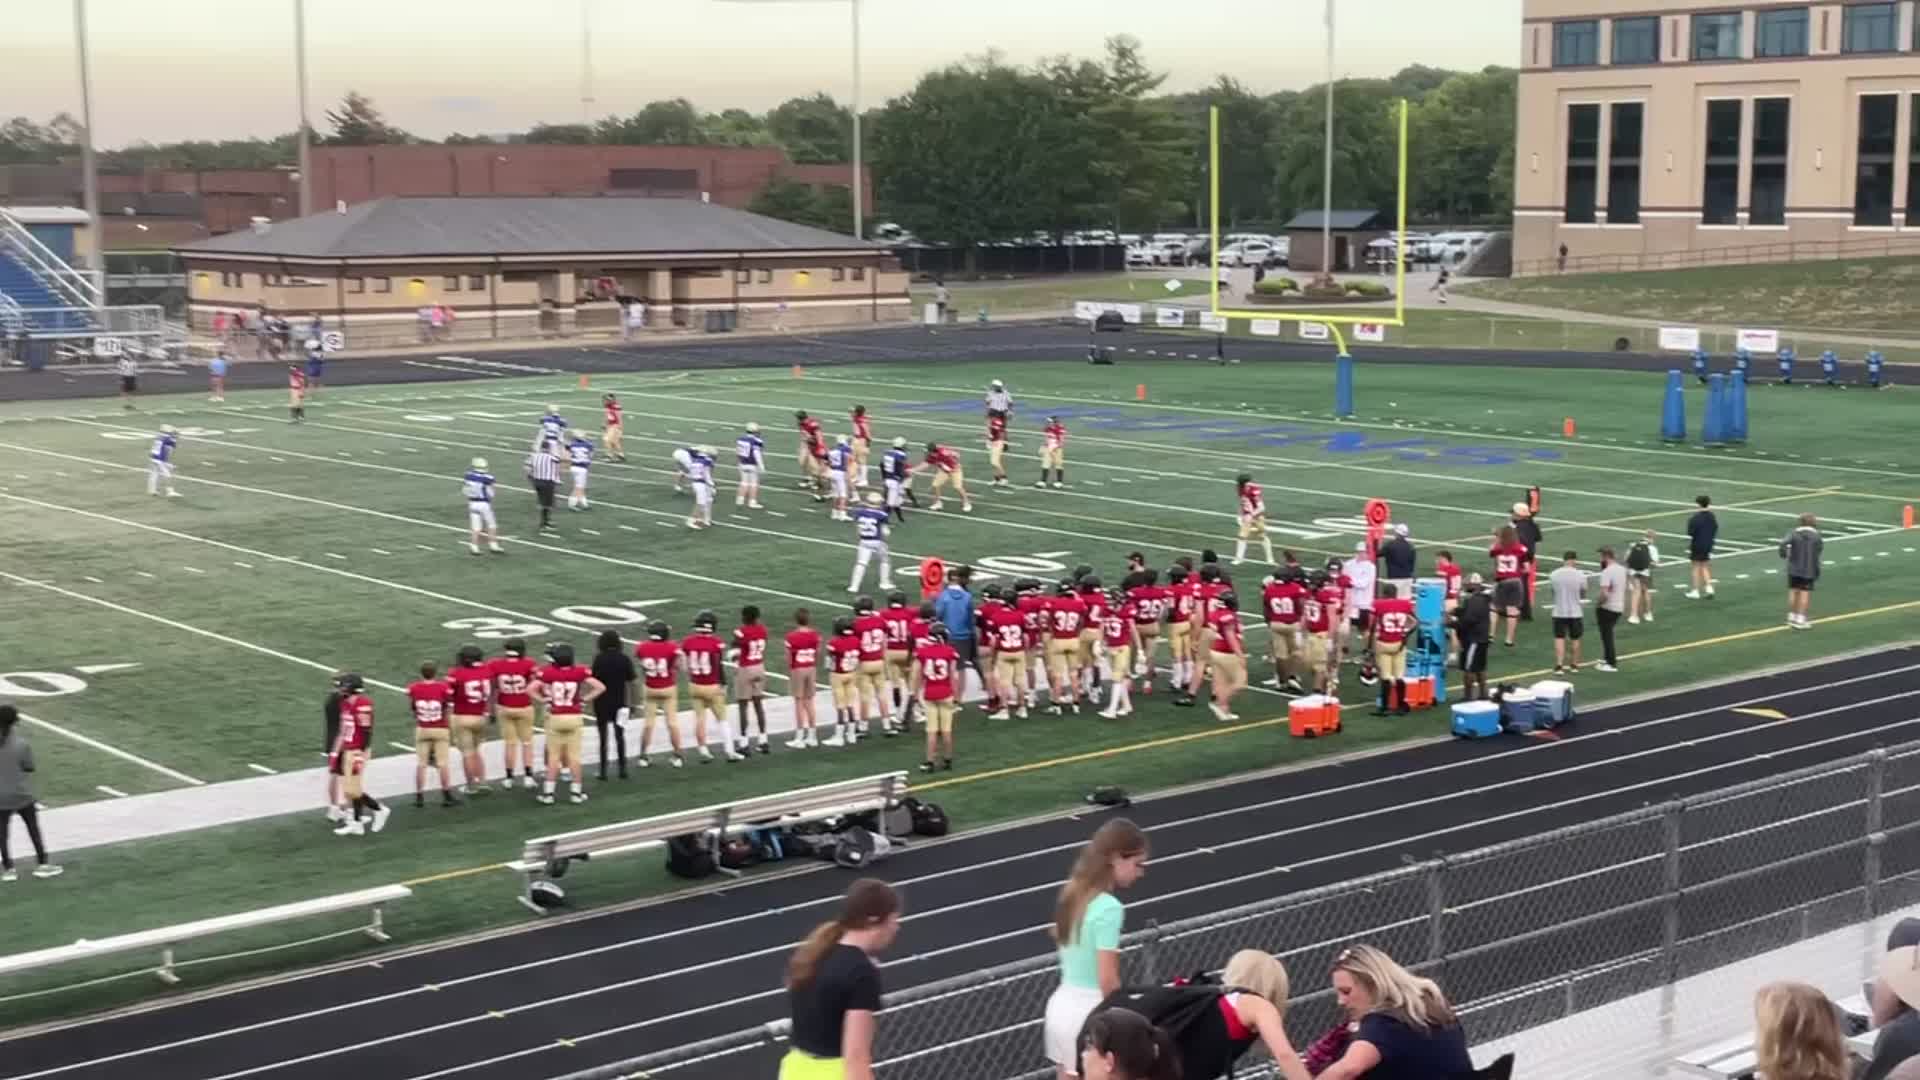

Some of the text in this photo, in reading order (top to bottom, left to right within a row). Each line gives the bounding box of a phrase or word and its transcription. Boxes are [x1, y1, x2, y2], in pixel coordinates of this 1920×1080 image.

[857, 517, 877, 536] 25
[441, 606, 648, 638] 30
[887, 620, 907, 642] 31
[925, 659, 948, 681] 43
